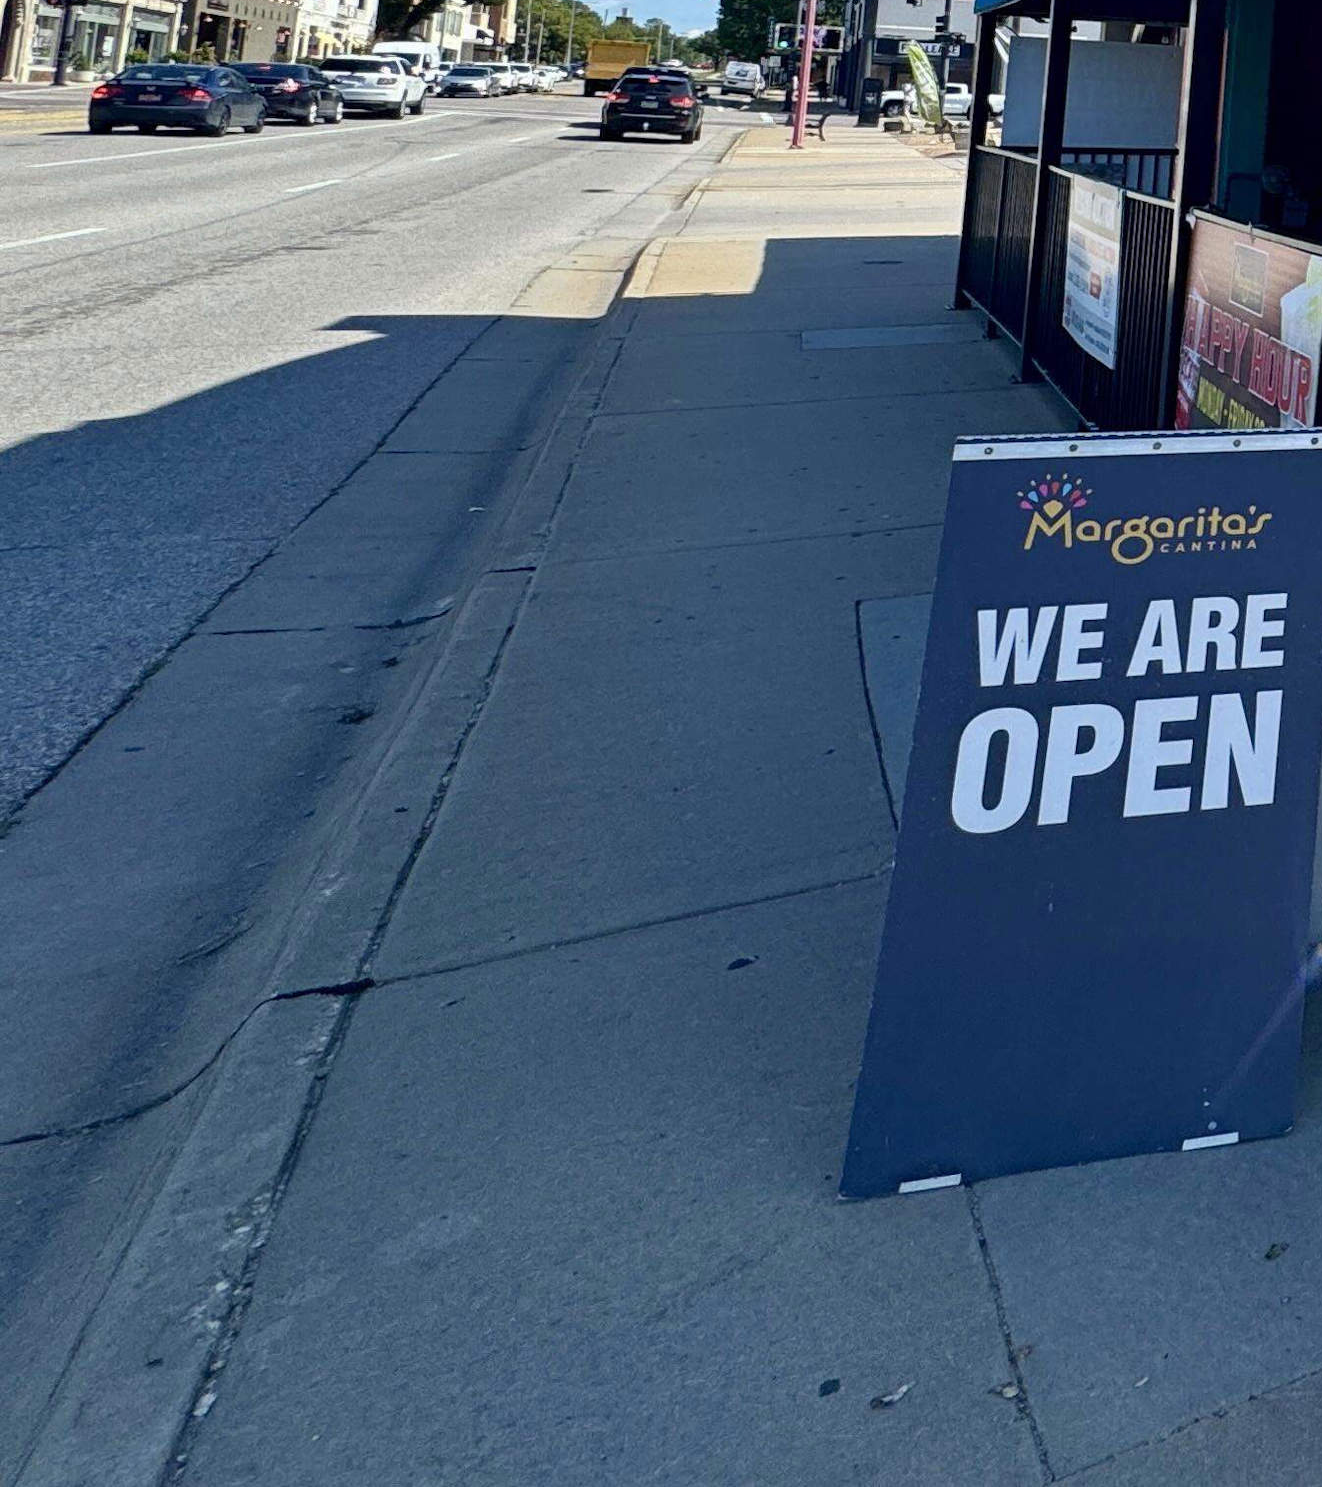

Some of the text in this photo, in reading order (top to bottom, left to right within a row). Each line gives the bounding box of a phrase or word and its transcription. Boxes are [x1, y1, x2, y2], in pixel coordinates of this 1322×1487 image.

[1247, 328, 1313, 428] HOUR
[1023, 504, 1273, 566] Margarita's
[1159, 539, 1259, 553] CANTINA
[976, 592, 1289, 688] WE ARE
[950, 689, 1283, 834] OPEN
